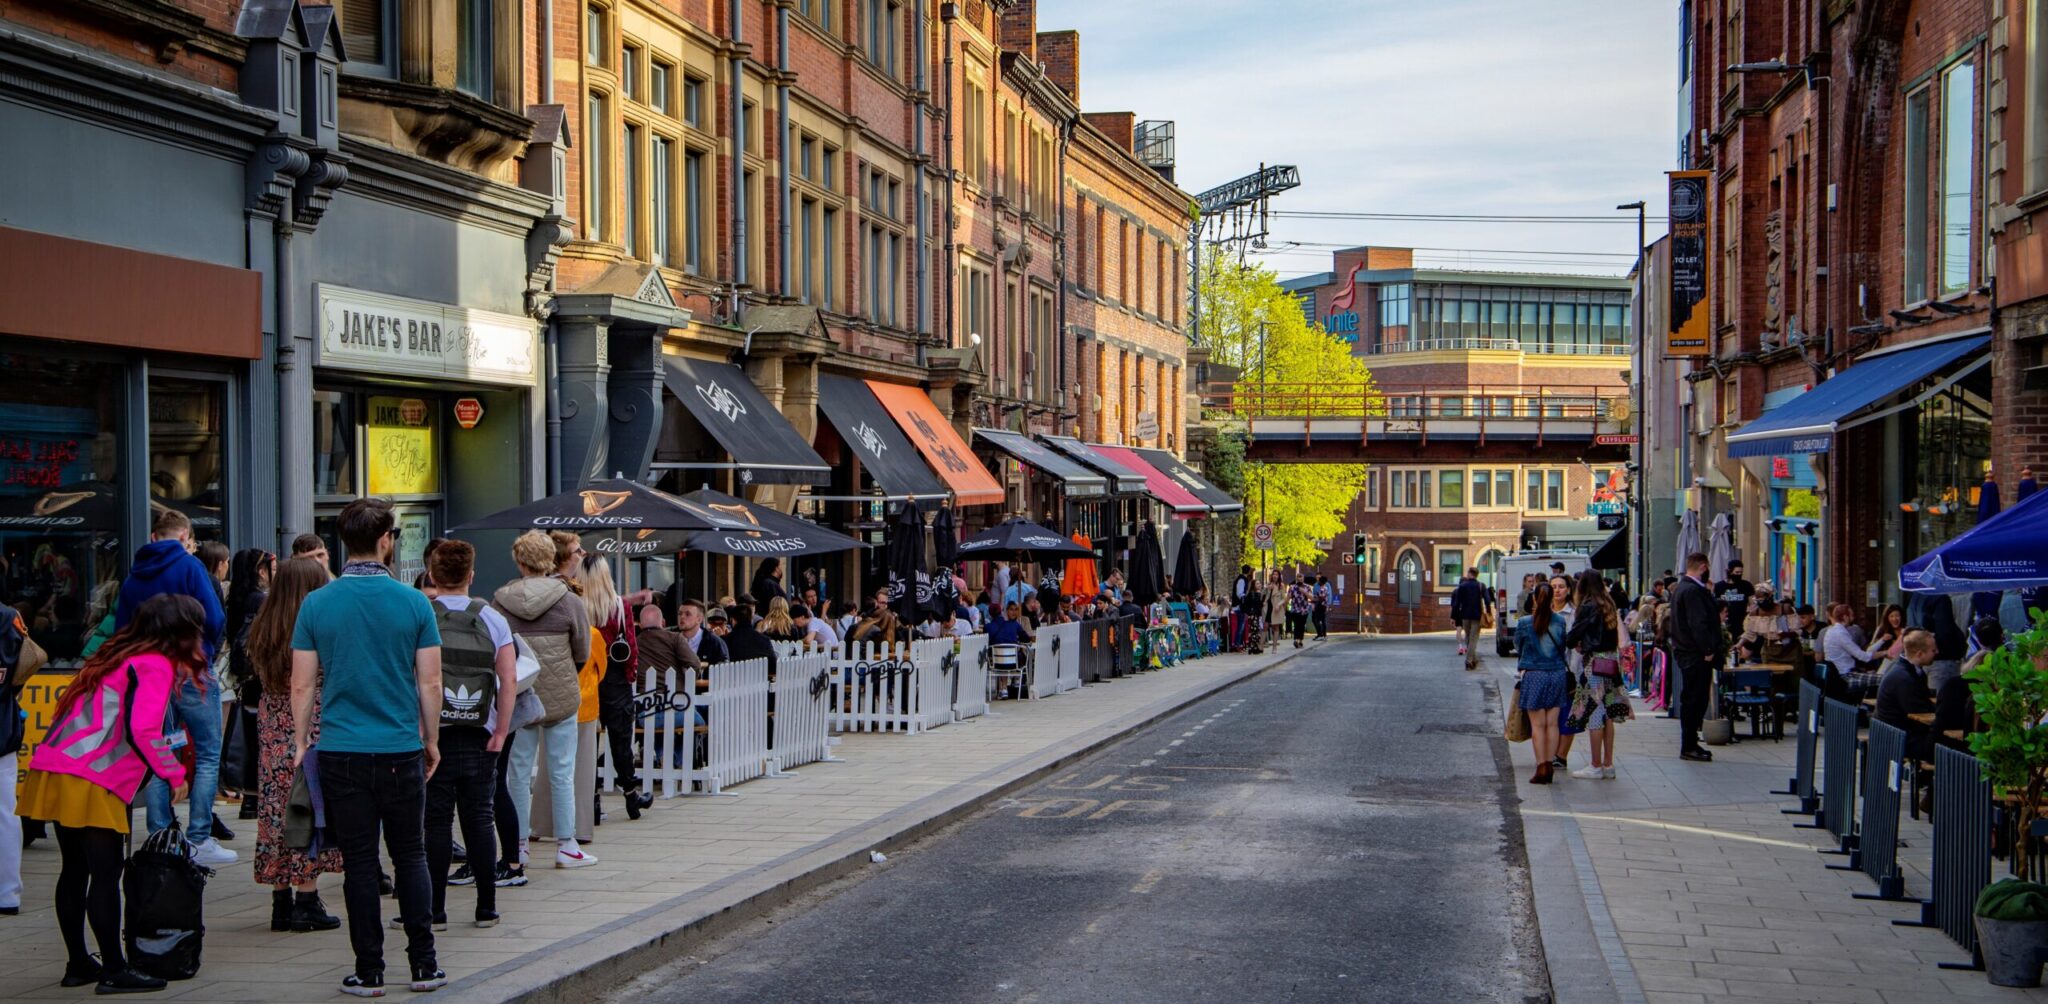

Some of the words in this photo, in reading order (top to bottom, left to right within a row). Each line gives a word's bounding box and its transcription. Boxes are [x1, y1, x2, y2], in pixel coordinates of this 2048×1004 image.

[1674, 223, 1706, 231] RUTLAND
[340, 309, 401, 352] JAKE'S
[407, 318, 442, 355] BAR
[532, 516, 644, 525] GUINNESS
[595, 537, 662, 554] GUINNESS
[724, 536, 807, 553] GUINNESS
[1959, 560, 1991, 568] LONDON
[440, 710, 480, 720] adidas
